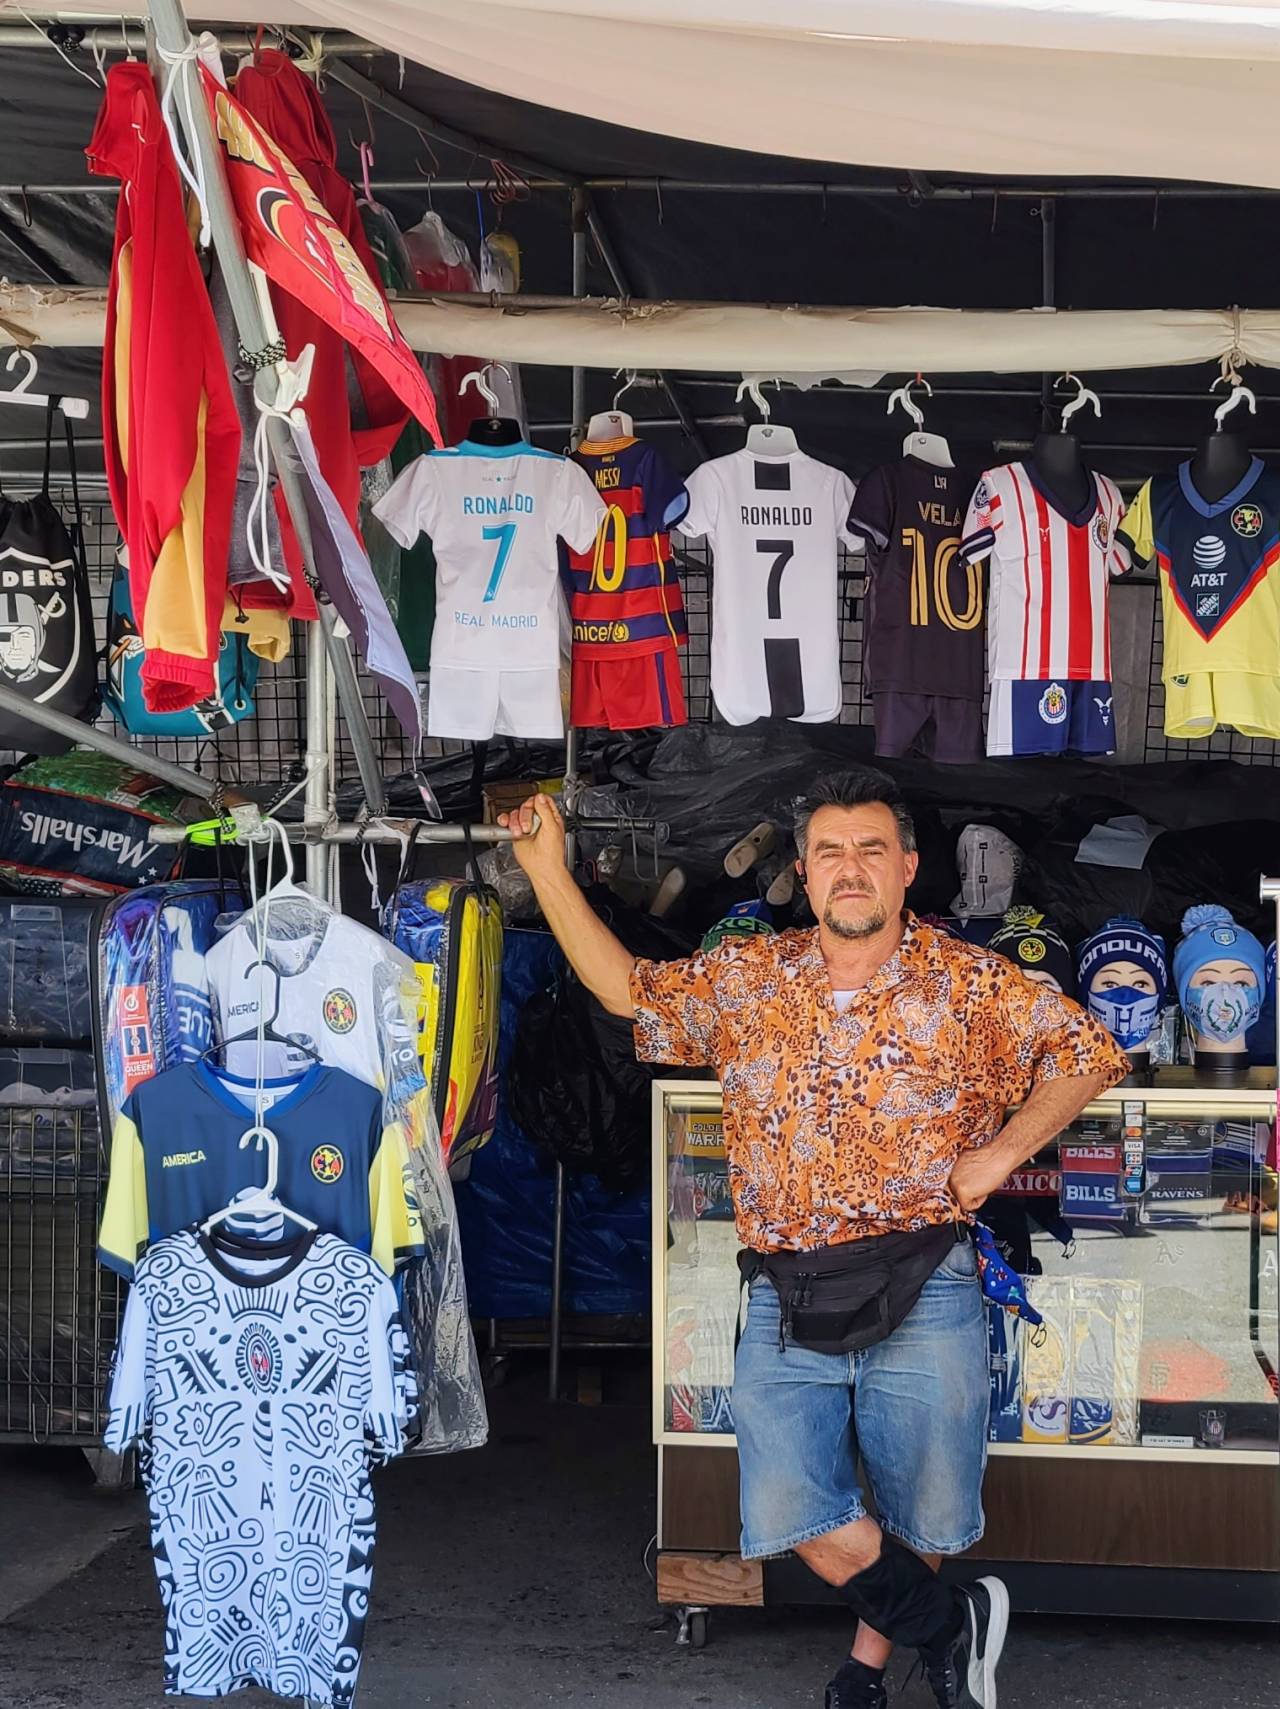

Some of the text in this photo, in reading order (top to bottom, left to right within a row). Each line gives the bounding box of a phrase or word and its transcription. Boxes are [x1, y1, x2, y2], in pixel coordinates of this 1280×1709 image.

[595, 468, 621, 488] MESSI
[463, 494, 533, 514] RONALDO
[918, 501, 961, 526] VELA
[740, 505, 812, 526] RONALDO
[482, 521, 517, 603] 7
[756, 539, 794, 619] 7
[902, 528, 983, 631] 10
[1190, 572, 1228, 588] AT&T
[455, 611, 538, 628] REAL MADRID
[573, 622, 612, 642] nicef
[1113, 1005, 1136, 1034] H
[125, 1063, 153, 1073] QUEEN
[162, 1150, 207, 1168] AMERICA
[1066, 1147, 1116, 1160] BILLS
[1066, 1185, 1116, 1202] BILLS
[1151, 1189, 1205, 1200] RAVENS
